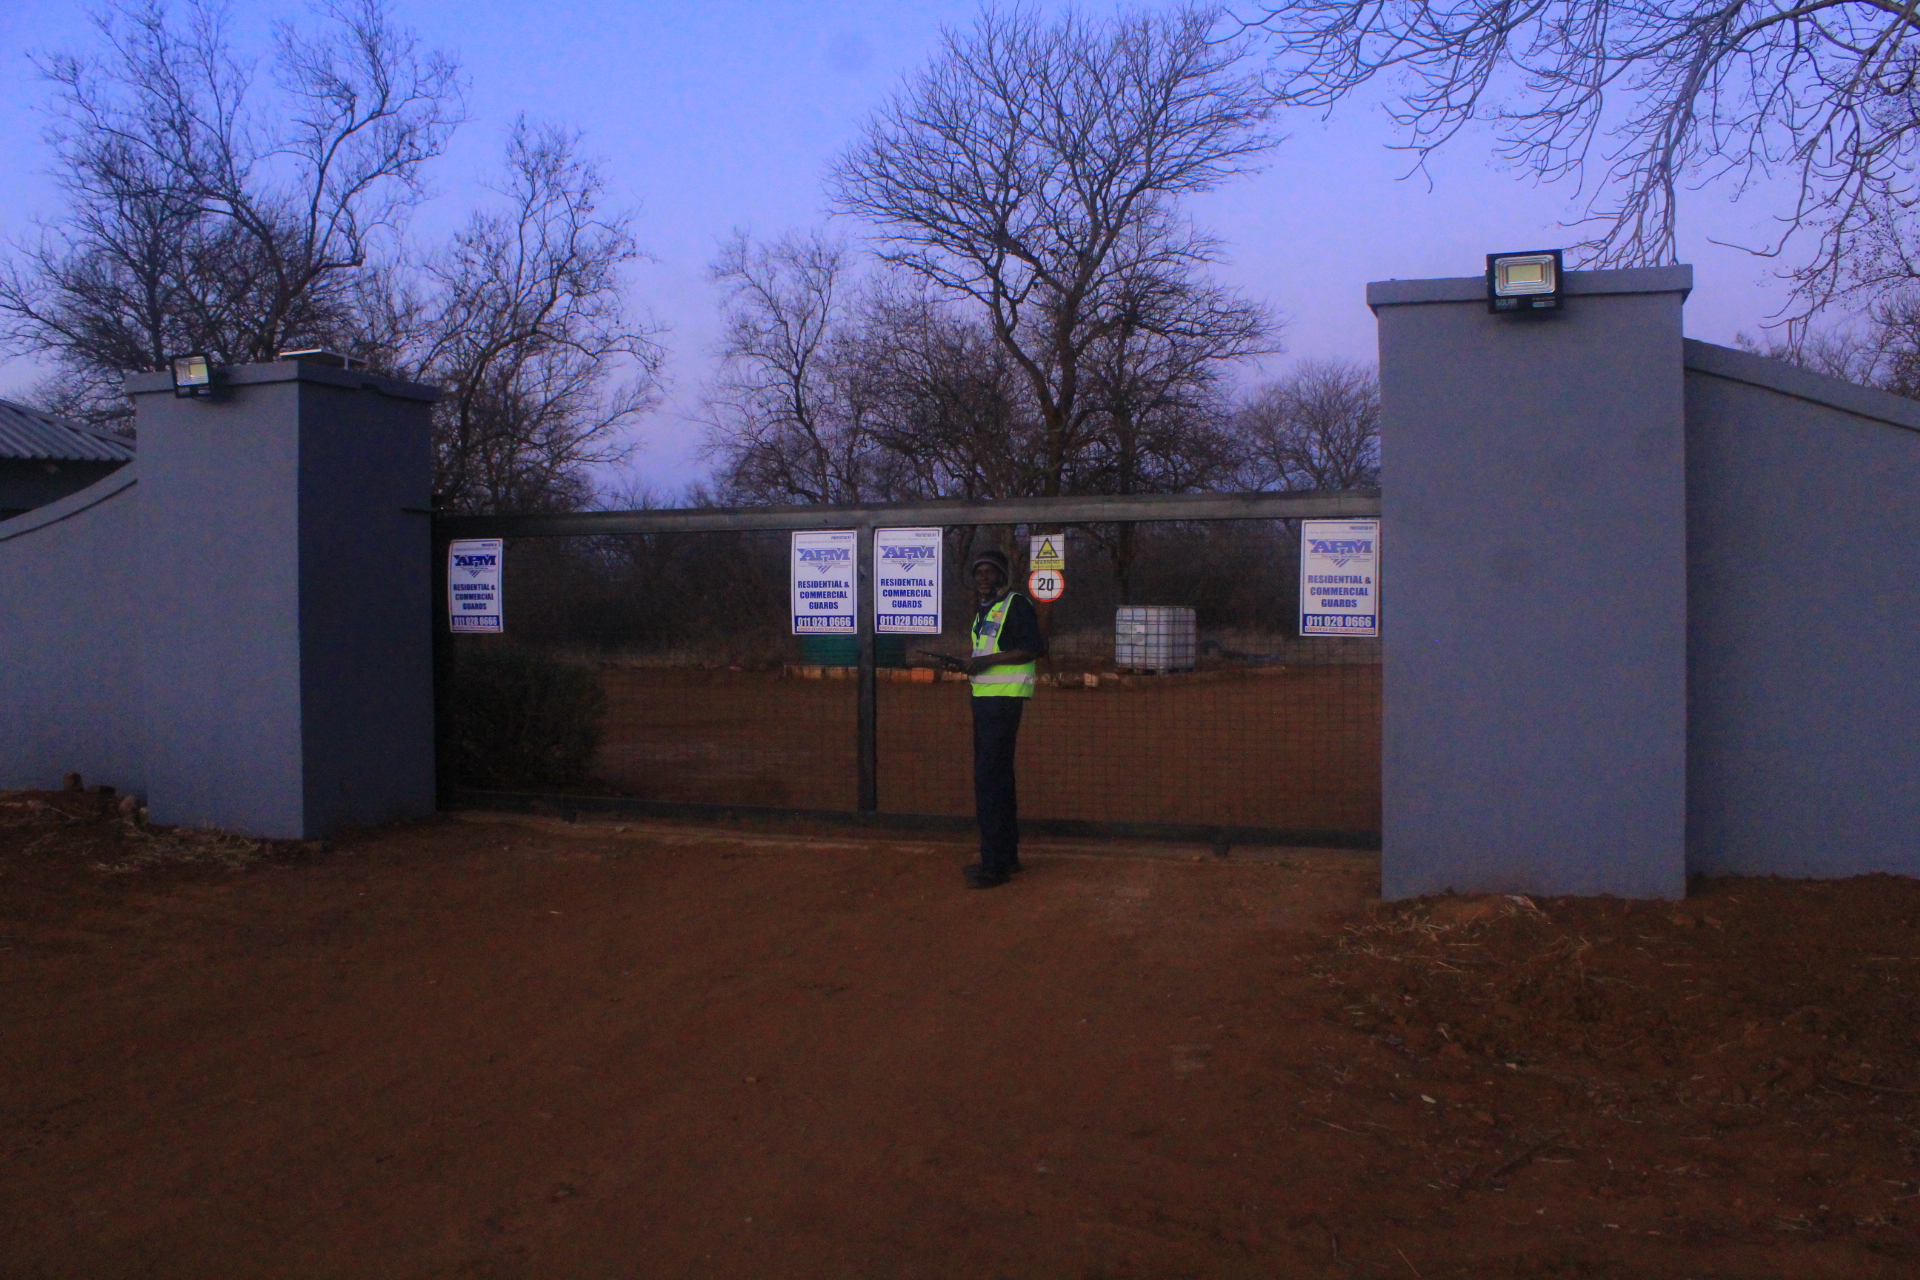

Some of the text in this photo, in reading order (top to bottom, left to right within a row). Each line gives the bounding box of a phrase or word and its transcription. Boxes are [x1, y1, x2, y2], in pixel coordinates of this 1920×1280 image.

[880, 578, 926, 586] RESIDENTIAL
[1308, 575, 1371, 584] RESIDENTIAL &
[453, 583, 490, 591] RESIDENTIAL
[798, 580, 842, 588] RESIDENTIAL
[1038, 577, 1054, 591] 20
[800, 591, 848, 599] COMMERCIAL
[882, 589, 931, 597] COMMERCIAL
[1310, 587, 1368, 596] COMMERCIAL
[809, 601, 838, 609] GUARDS
[892, 600, 922, 608] GUARDS
[1321, 599, 1357, 607] GUARDS
[798, 616, 851, 626] 011 028 0666
[880, 615, 934, 625] 011 028 0666
[1306, 615, 1372, 627] 011 028 0666
